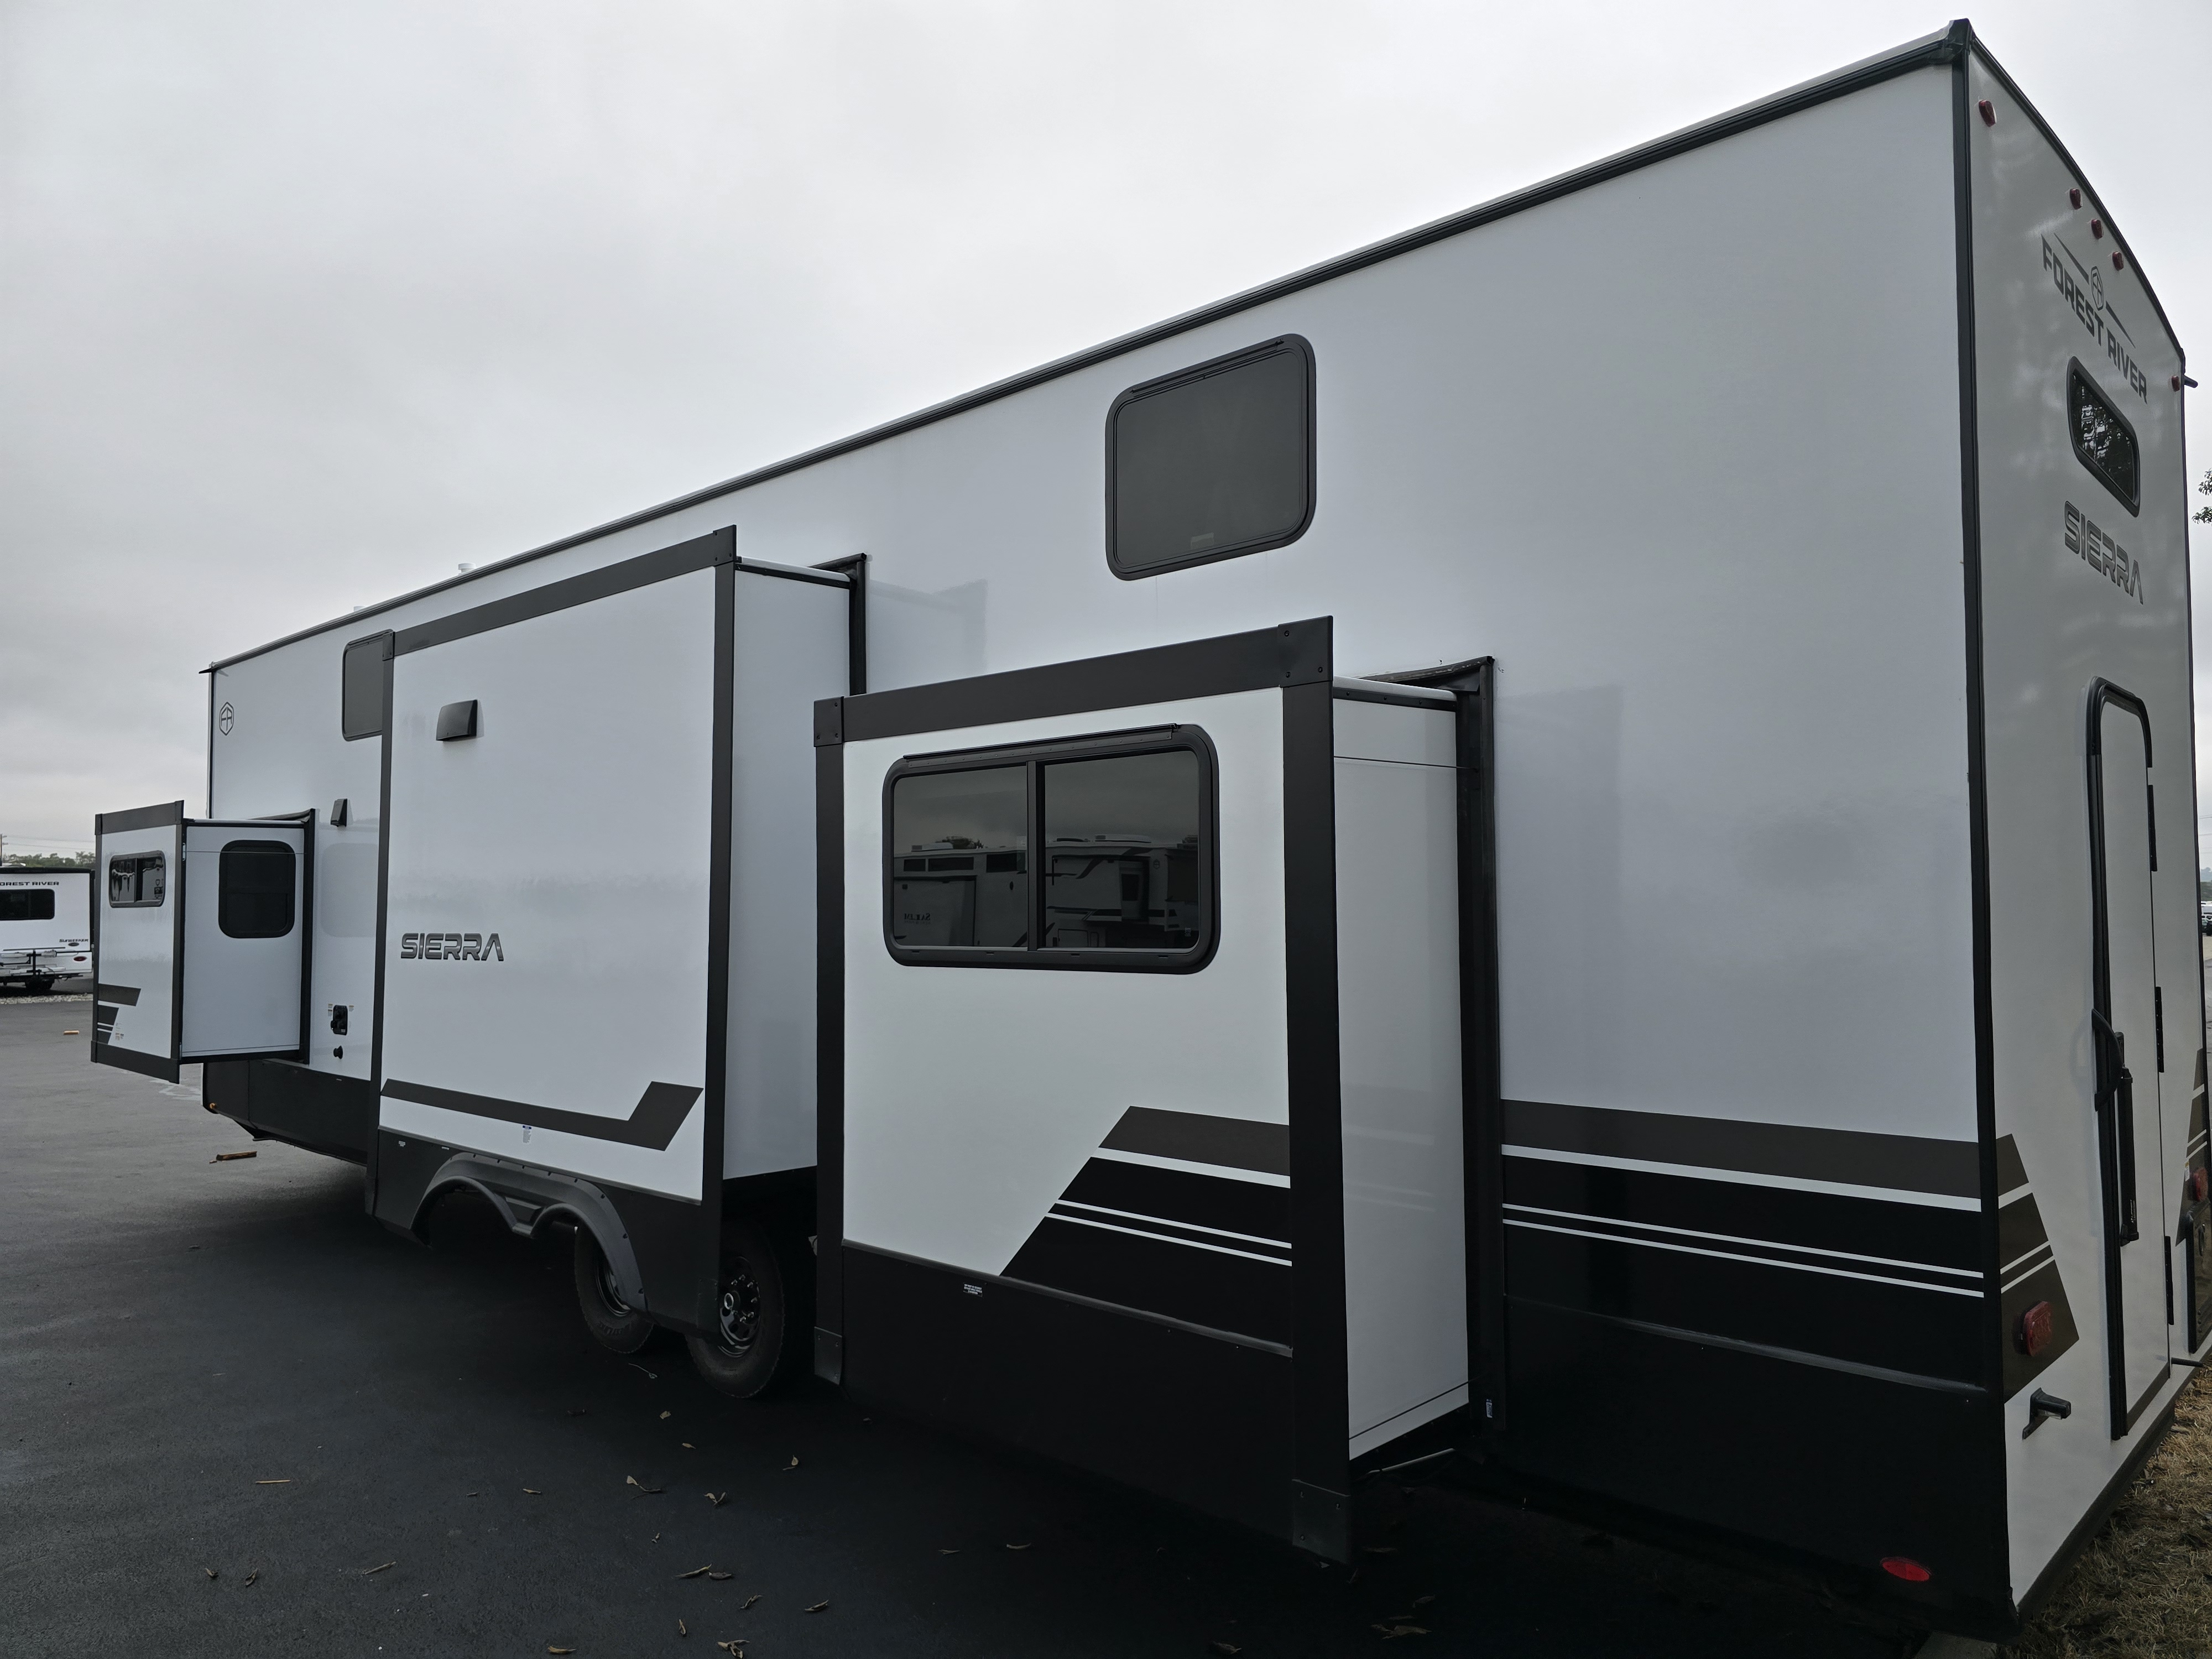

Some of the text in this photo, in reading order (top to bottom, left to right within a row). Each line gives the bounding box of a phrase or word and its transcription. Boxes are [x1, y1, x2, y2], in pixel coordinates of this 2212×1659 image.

[2041, 233, 2148, 404] FOREST RIVER
[2064, 500, 2143, 605] SIERRA
[400, 932, 504, 962] SIERRA
